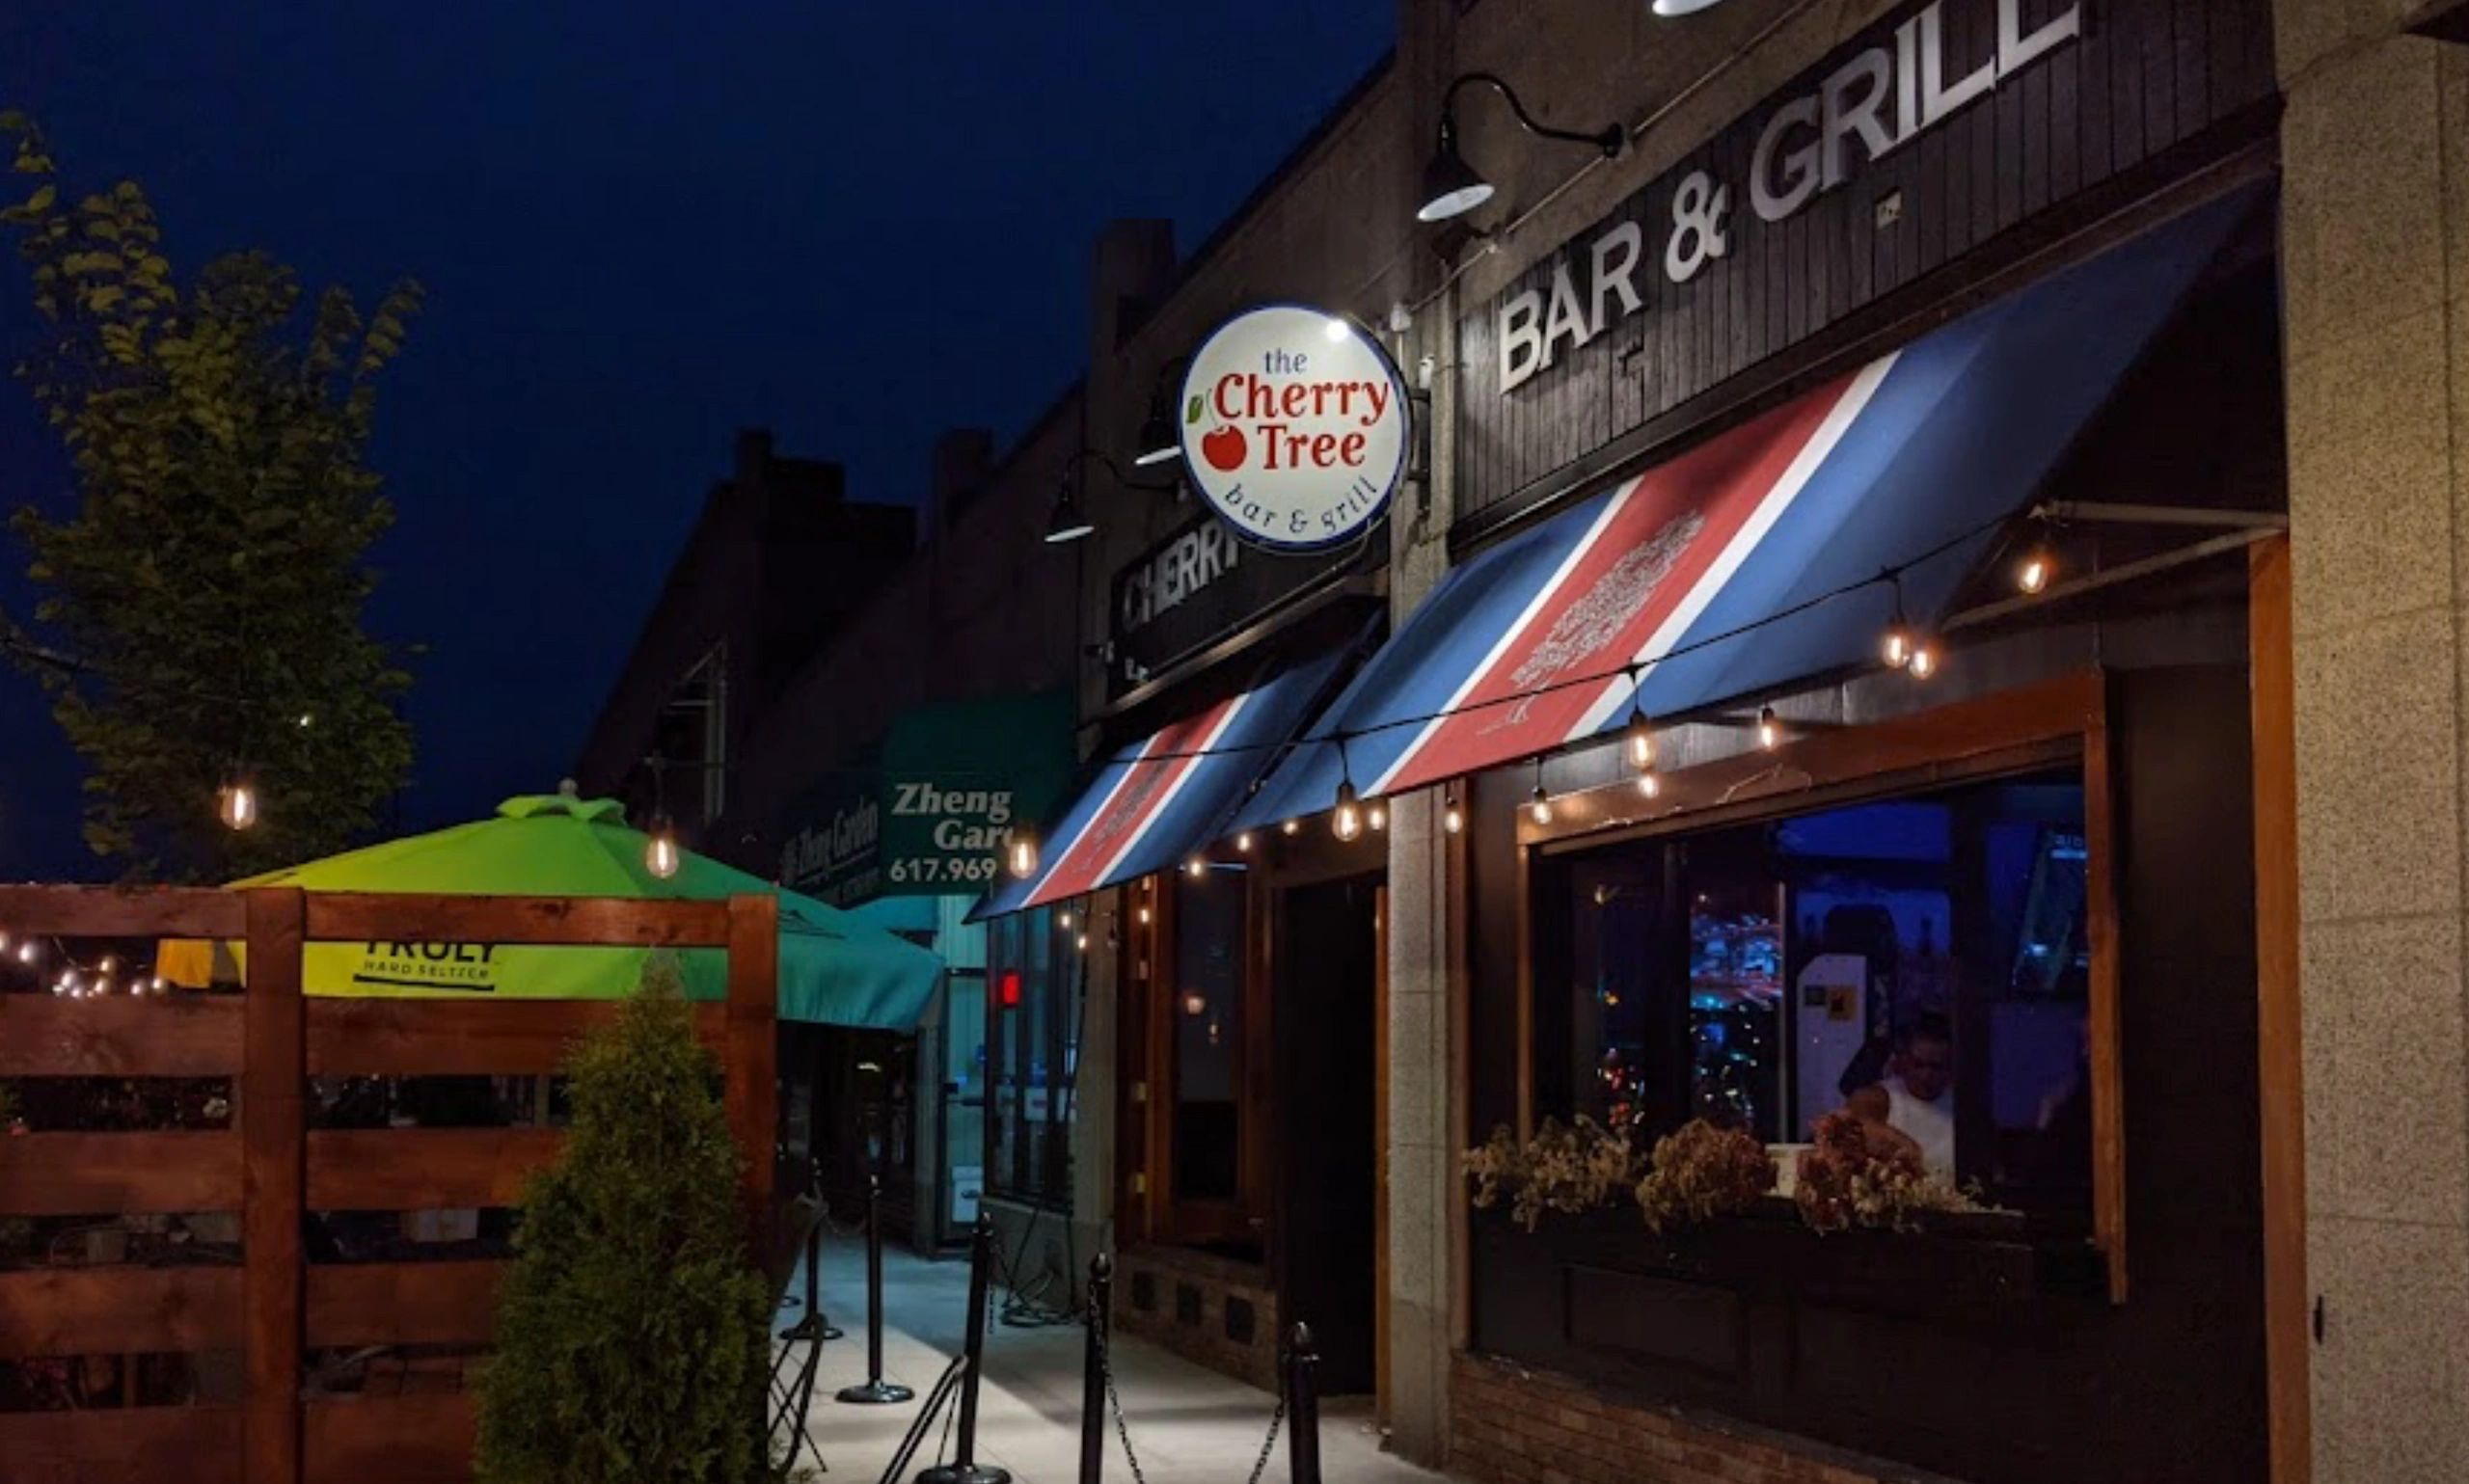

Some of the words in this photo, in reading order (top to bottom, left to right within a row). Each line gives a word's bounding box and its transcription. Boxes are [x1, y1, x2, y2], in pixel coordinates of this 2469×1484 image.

[1499, 220, 1643, 396] BAR
[1665, 171, 1730, 283] &
[1749, 0, 2080, 223] GRILL
[1263, 348, 1308, 375] the
[1214, 373, 1389, 426] Cherry
[1258, 424, 1367, 471] Tree
[1224, 483, 1278, 527] bar
[1289, 509, 1308, 533] &
[1320, 474, 1377, 534] grill
[891, 782, 1012, 824] Zheng
[889, 857, 997, 883] 617.969
[364, 960, 412, 975] HARD
[418, 964, 490, 980] SELTZER
